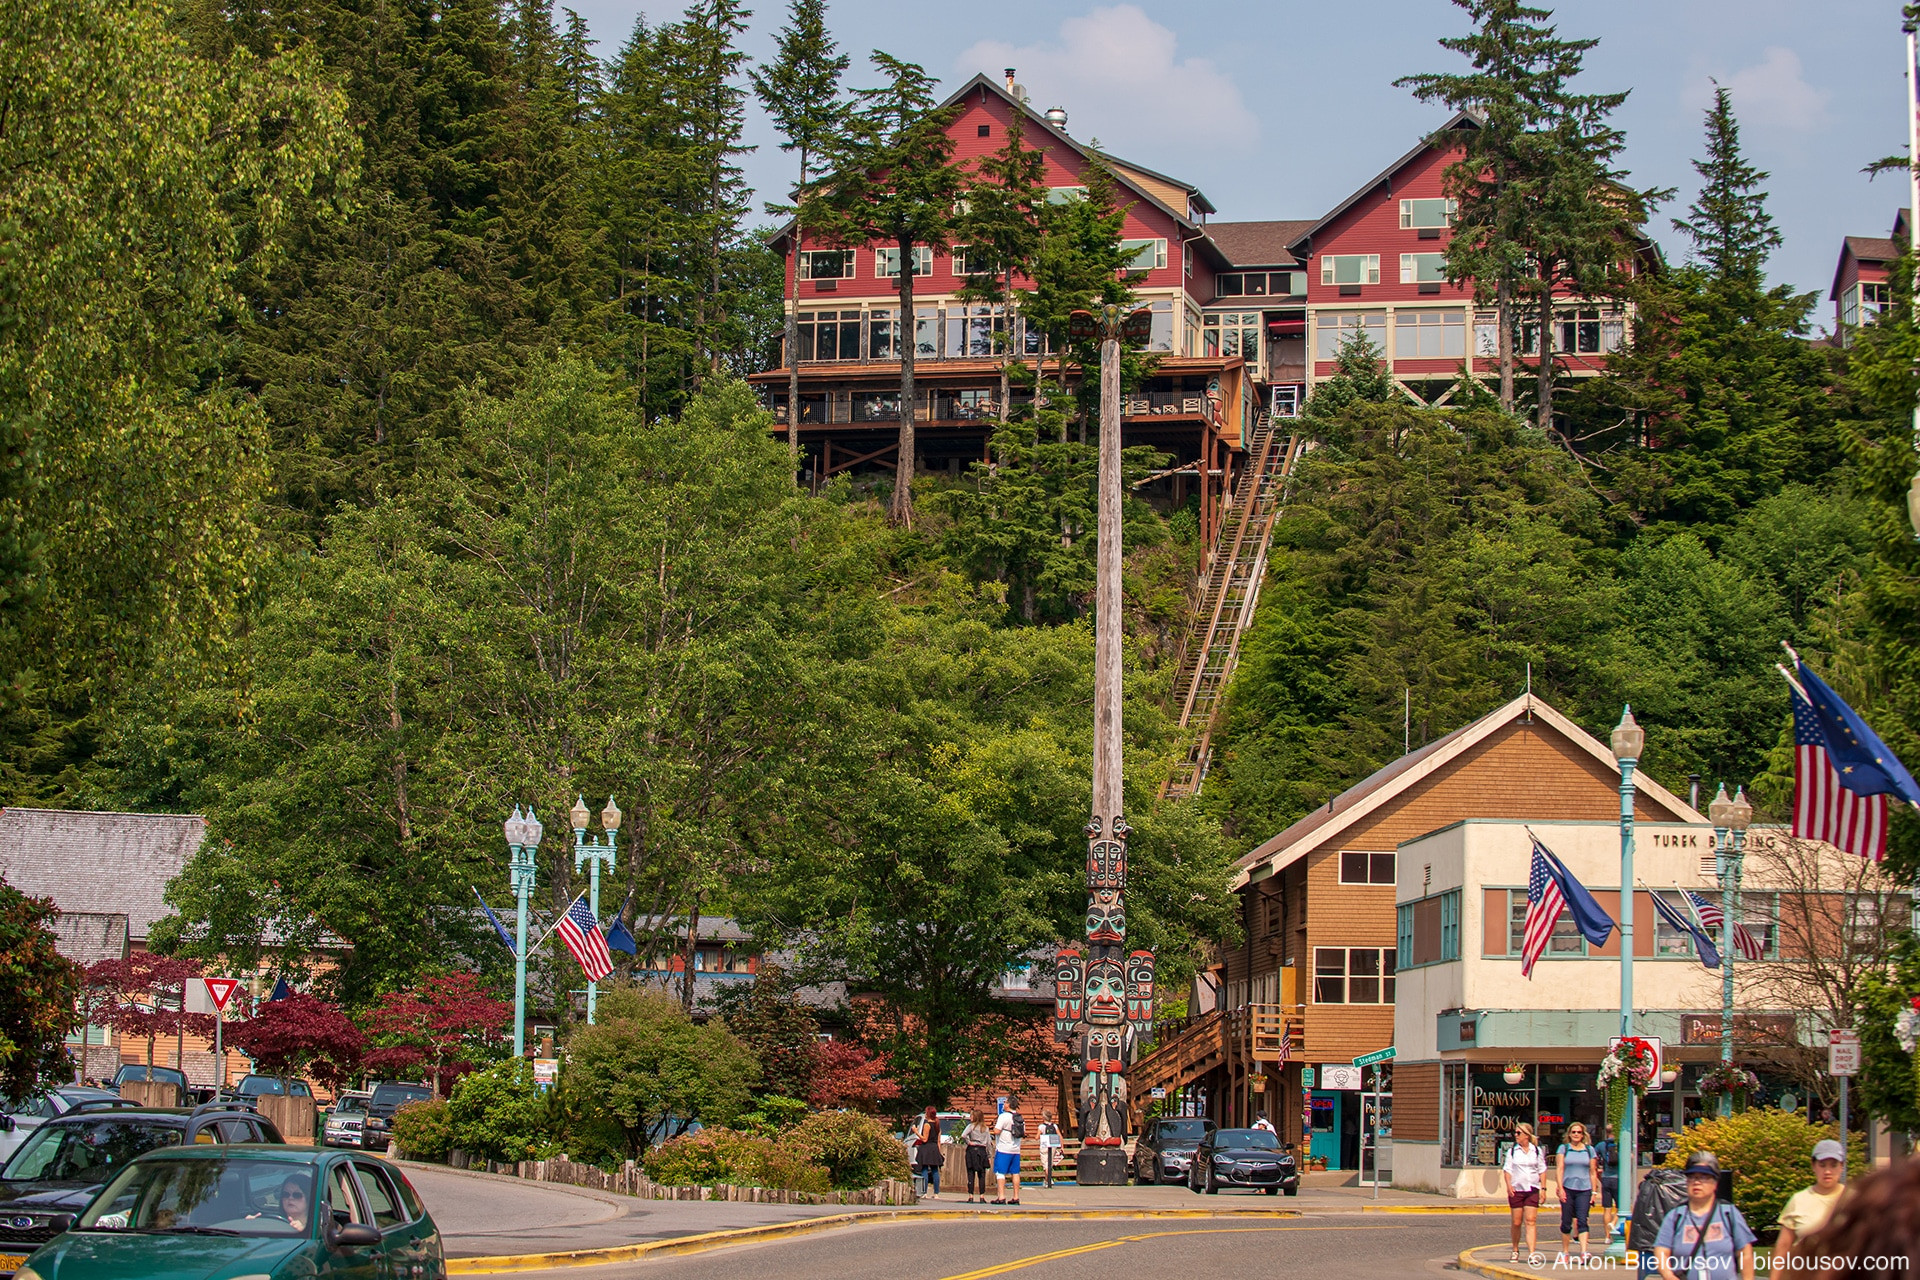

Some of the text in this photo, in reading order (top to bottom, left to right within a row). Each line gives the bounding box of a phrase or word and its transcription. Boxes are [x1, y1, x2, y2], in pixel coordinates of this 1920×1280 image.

[1653, 834, 1776, 848] TUREK BDING
[1474, 1086, 1531, 1106] PARNASSUS
[1311, 1100, 1333, 1108] OPEN
[1539, 1115, 1564, 1123] OPEN
